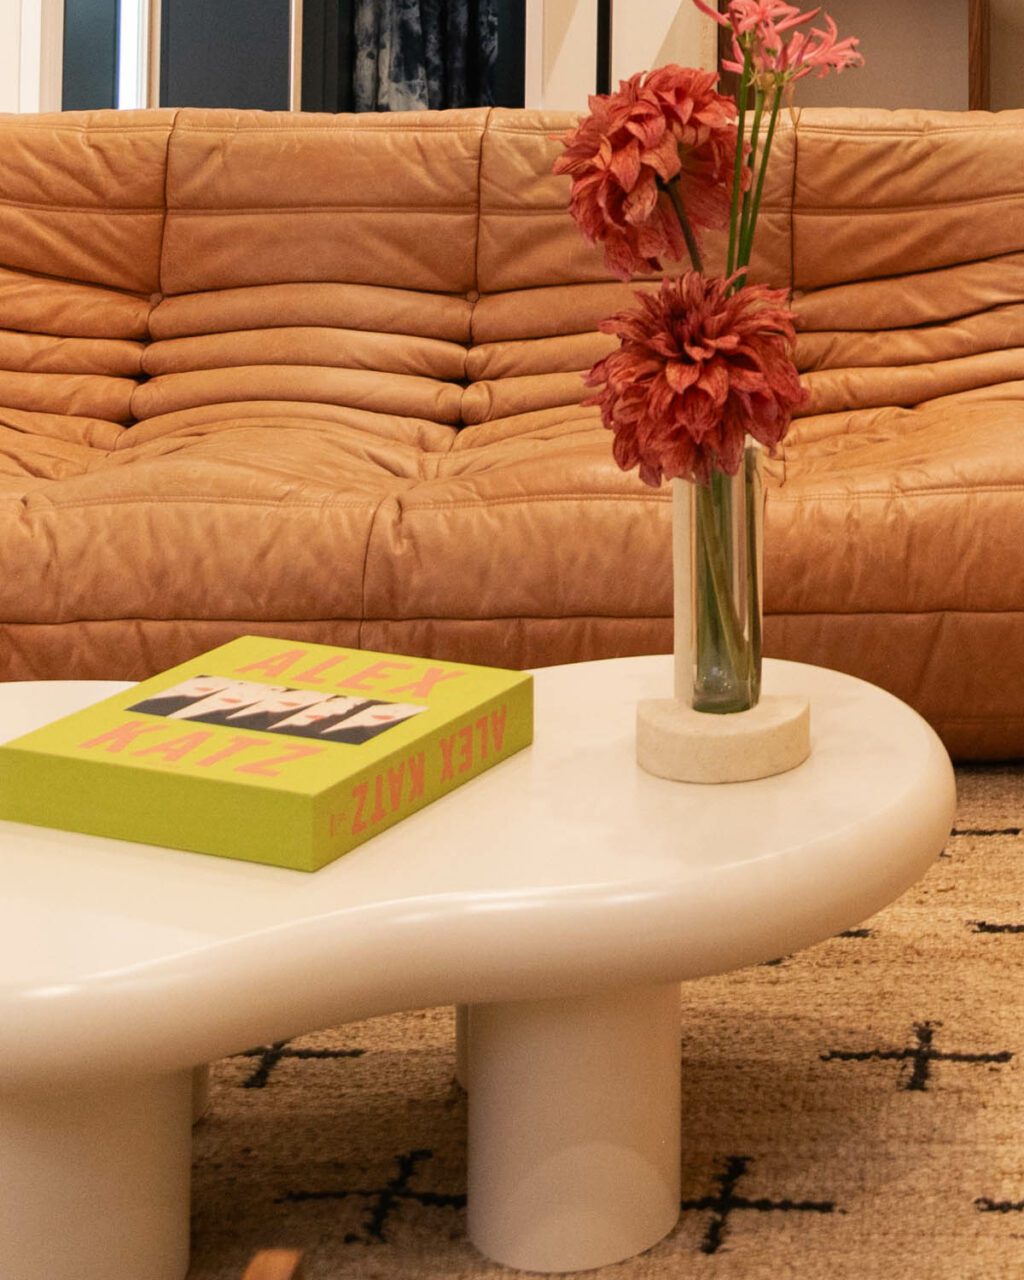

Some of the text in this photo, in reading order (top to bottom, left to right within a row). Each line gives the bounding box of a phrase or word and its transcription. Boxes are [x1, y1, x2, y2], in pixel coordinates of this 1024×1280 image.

[234, 648, 466, 698] ALEX
[78, 720, 326, 778] KATZ
[351, 705, 508, 836] ALEX KATZ
